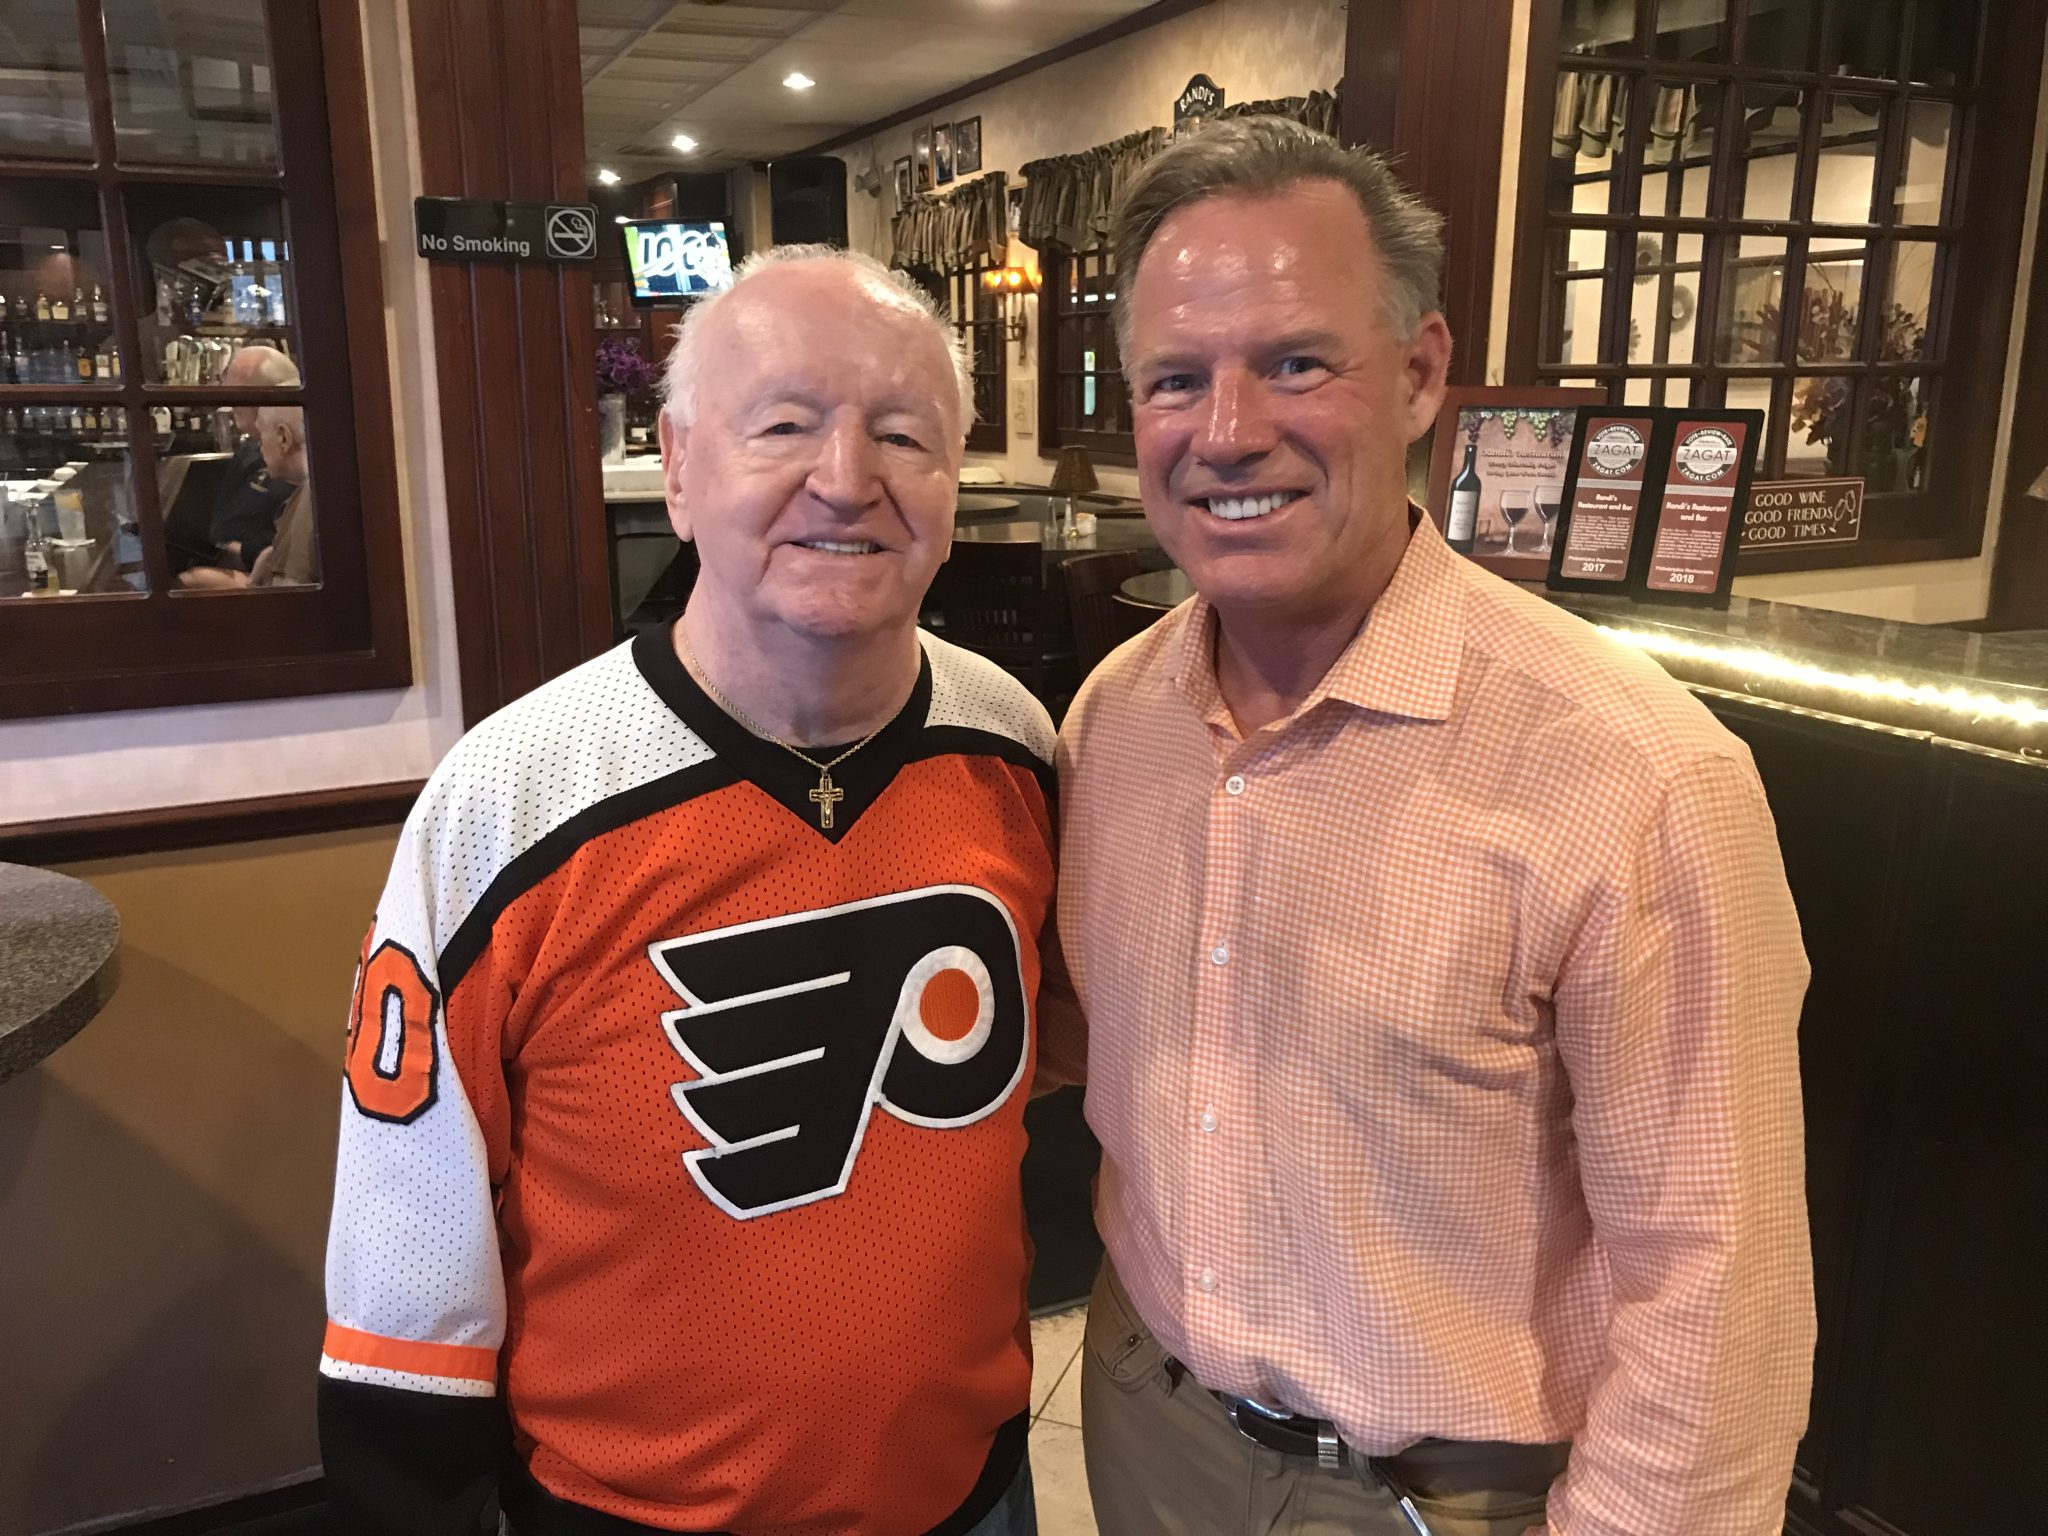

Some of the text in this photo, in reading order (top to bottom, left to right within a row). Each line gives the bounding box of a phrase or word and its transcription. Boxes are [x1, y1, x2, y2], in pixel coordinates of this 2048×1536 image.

[1180, 86, 1215, 112] RANDI'S
[422, 234, 530, 257] No Smoking
[1594, 444, 1639, 457] ZAGAT
[1683, 448, 1731, 462] ZAGAT
[1596, 493, 1618, 502] Randi's
[1755, 490, 1827, 507] GOOD WINE
[1577, 501, 1608, 510] Restaurant
[1622, 503, 1633, 511] Bar
[1666, 501, 1728, 512] Randi's Restaurant
[1680, 513, 1708, 522] and Bar
[1744, 506, 1834, 525] GOOD FRIENDS
[1748, 523, 1826, 541] GOOD TIMES
[1582, 562, 1606, 572] 2017
[1669, 572, 1695, 584] 2018
